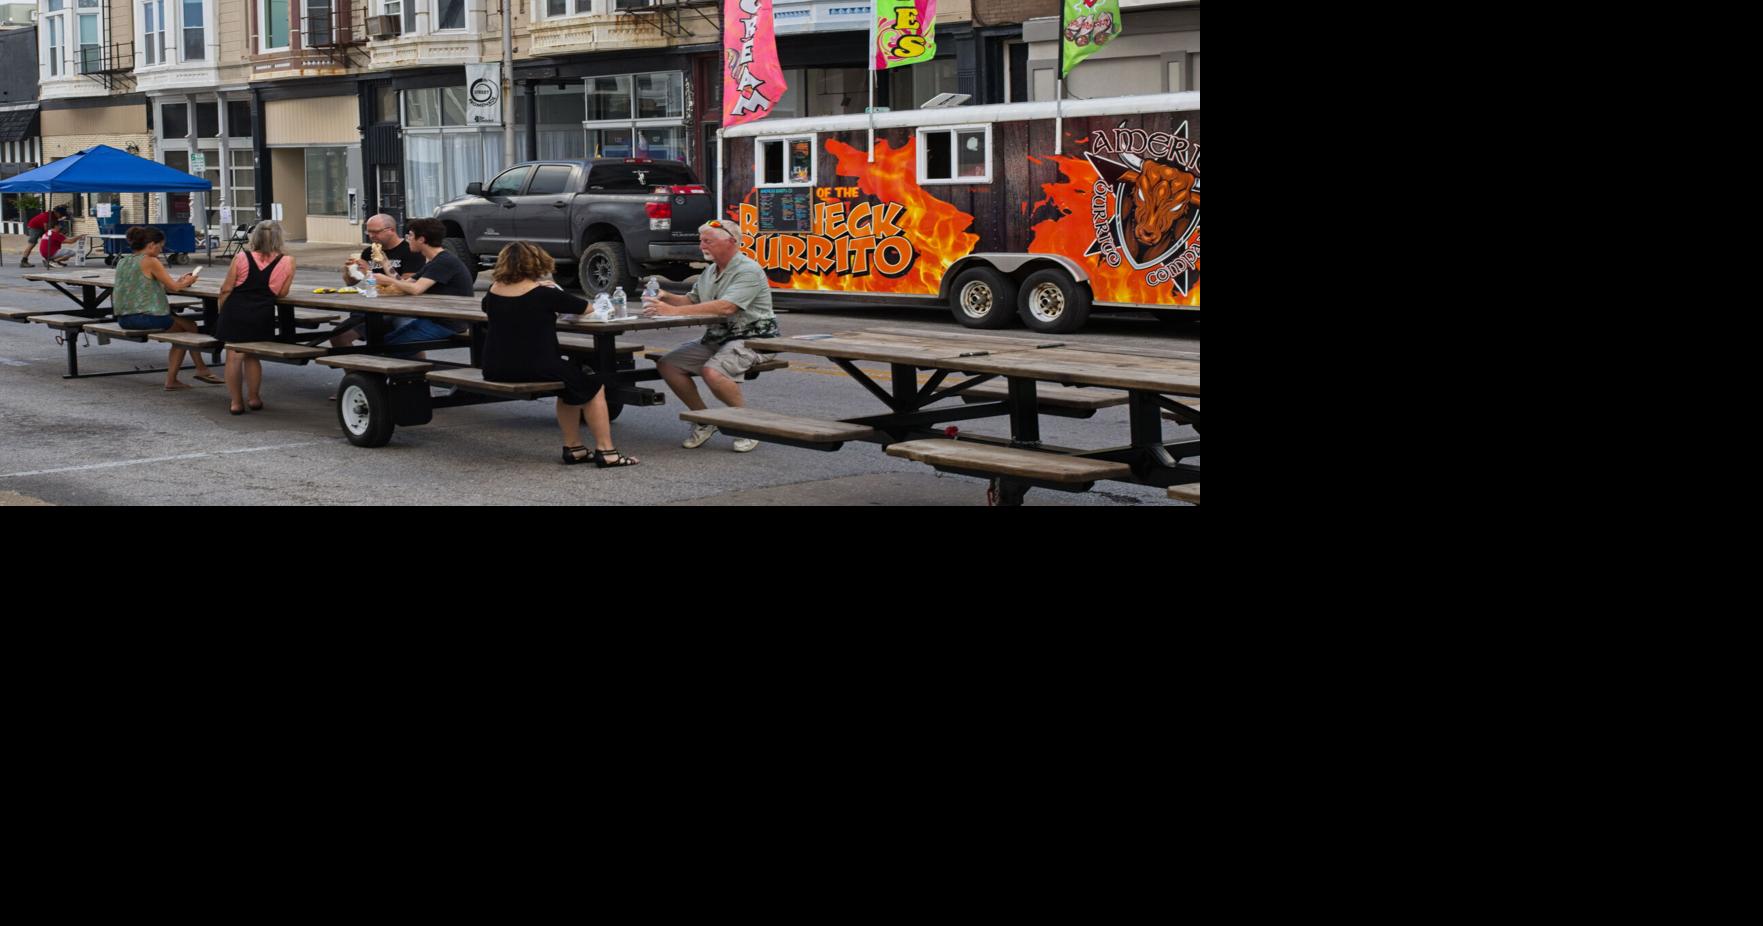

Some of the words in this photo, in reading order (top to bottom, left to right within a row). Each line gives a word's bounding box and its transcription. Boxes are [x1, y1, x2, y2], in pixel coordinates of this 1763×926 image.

[891, 1, 927, 58] ES
[1092, 128, 1200, 173] AMERI
[815, 186, 831, 198] OF
[834, 186, 860, 198] THE
[739, 201, 905, 239] RNECK
[1091, 179, 1122, 268] BURRITO
[738, 232, 914, 276] BURRITO
[1145, 236, 1200, 287] COMPA
